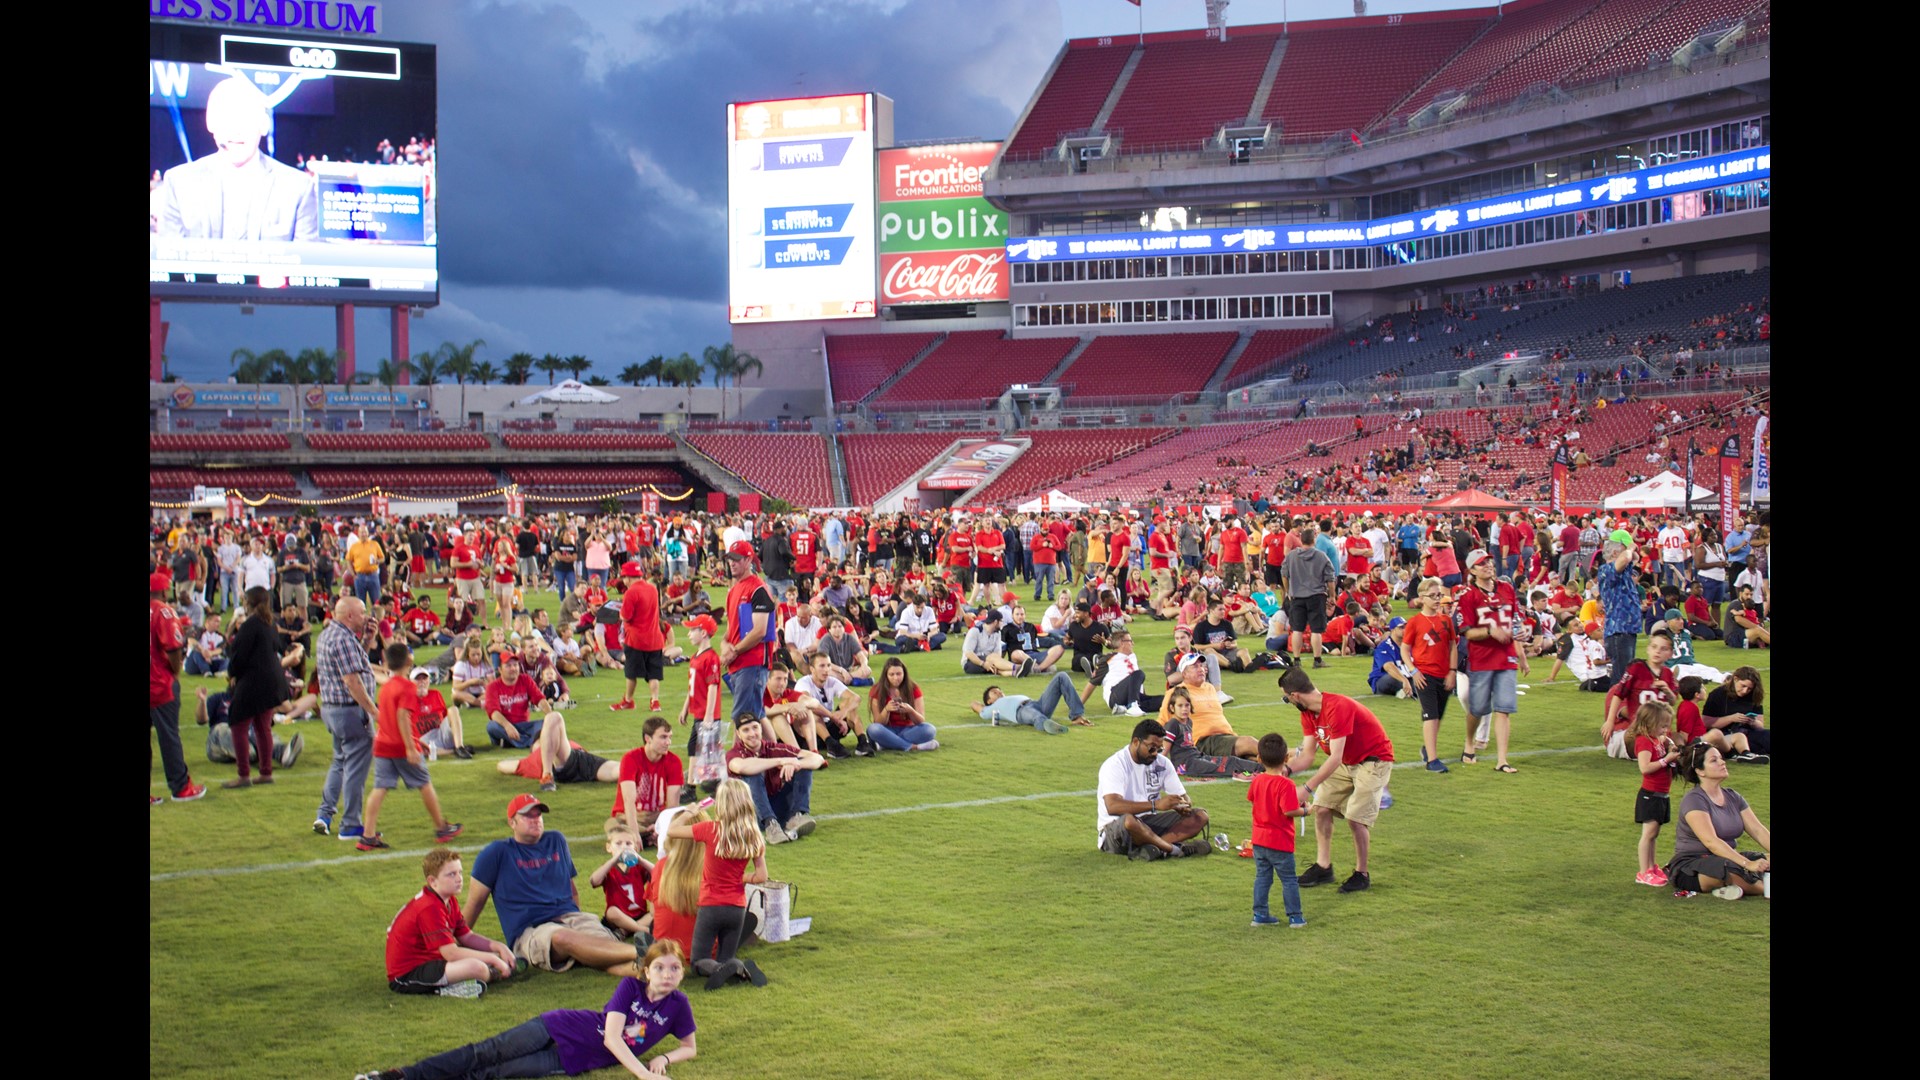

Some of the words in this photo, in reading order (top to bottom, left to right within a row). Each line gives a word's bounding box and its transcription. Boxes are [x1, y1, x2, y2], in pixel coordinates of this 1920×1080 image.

[211, 0, 377, 34] STADIUM
[895, 161, 989, 188] Frontier
[1664, 164, 1718, 187] ORIGINAL
[1719, 157, 1756, 176] LIGHT
[896, 183, 984, 197] COMMUNICATIONS
[771, 216, 834, 231] SEAHAWKS
[881, 207, 1000, 243] Publix
[1306, 228, 1365, 243] ORIGINAL
[1086, 238, 1142, 253] ORIGINAL
[1143, 236, 1178, 251] LIGHT
[774, 249, 831, 263] COWBOYS
[883, 253, 1005, 298] Coca-Cola
[927, 479, 942, 487] TEAM
[942, 479, 958, 487] STORE
[959, 479, 979, 487] ACCESS
[1723, 474, 1733, 532] RECHARGE
[796, 540, 809, 555] 51
[1664, 536, 1680, 548] 40
[1476, 604, 1513, 636] 55
